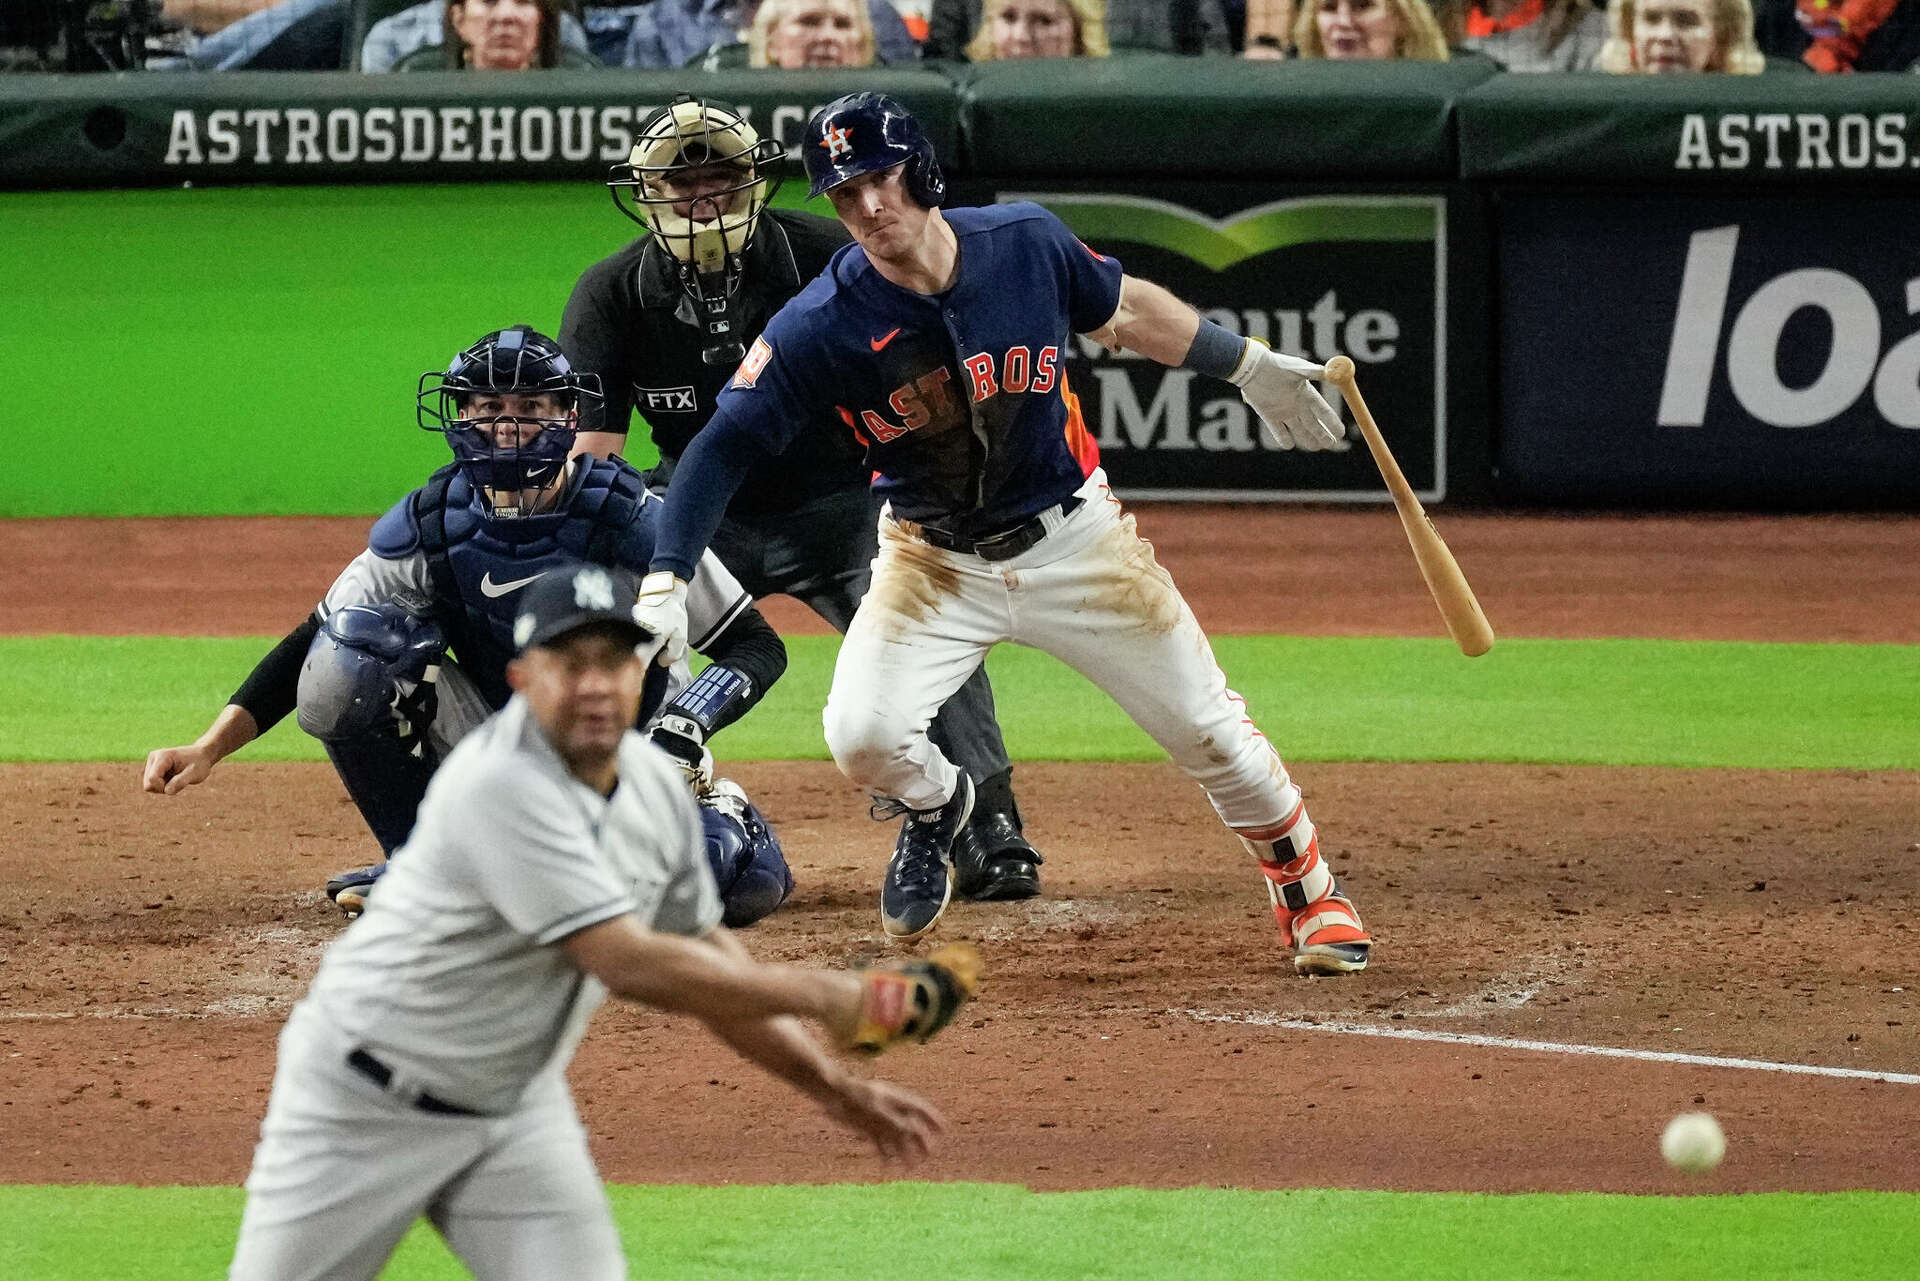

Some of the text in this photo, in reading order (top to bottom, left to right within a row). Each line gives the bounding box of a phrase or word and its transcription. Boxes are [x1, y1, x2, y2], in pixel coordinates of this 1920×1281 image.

[646, 390, 694, 410] FTX
[860, 345, 1058, 444] ASTROS
[918, 809, 943, 823] NIKE
